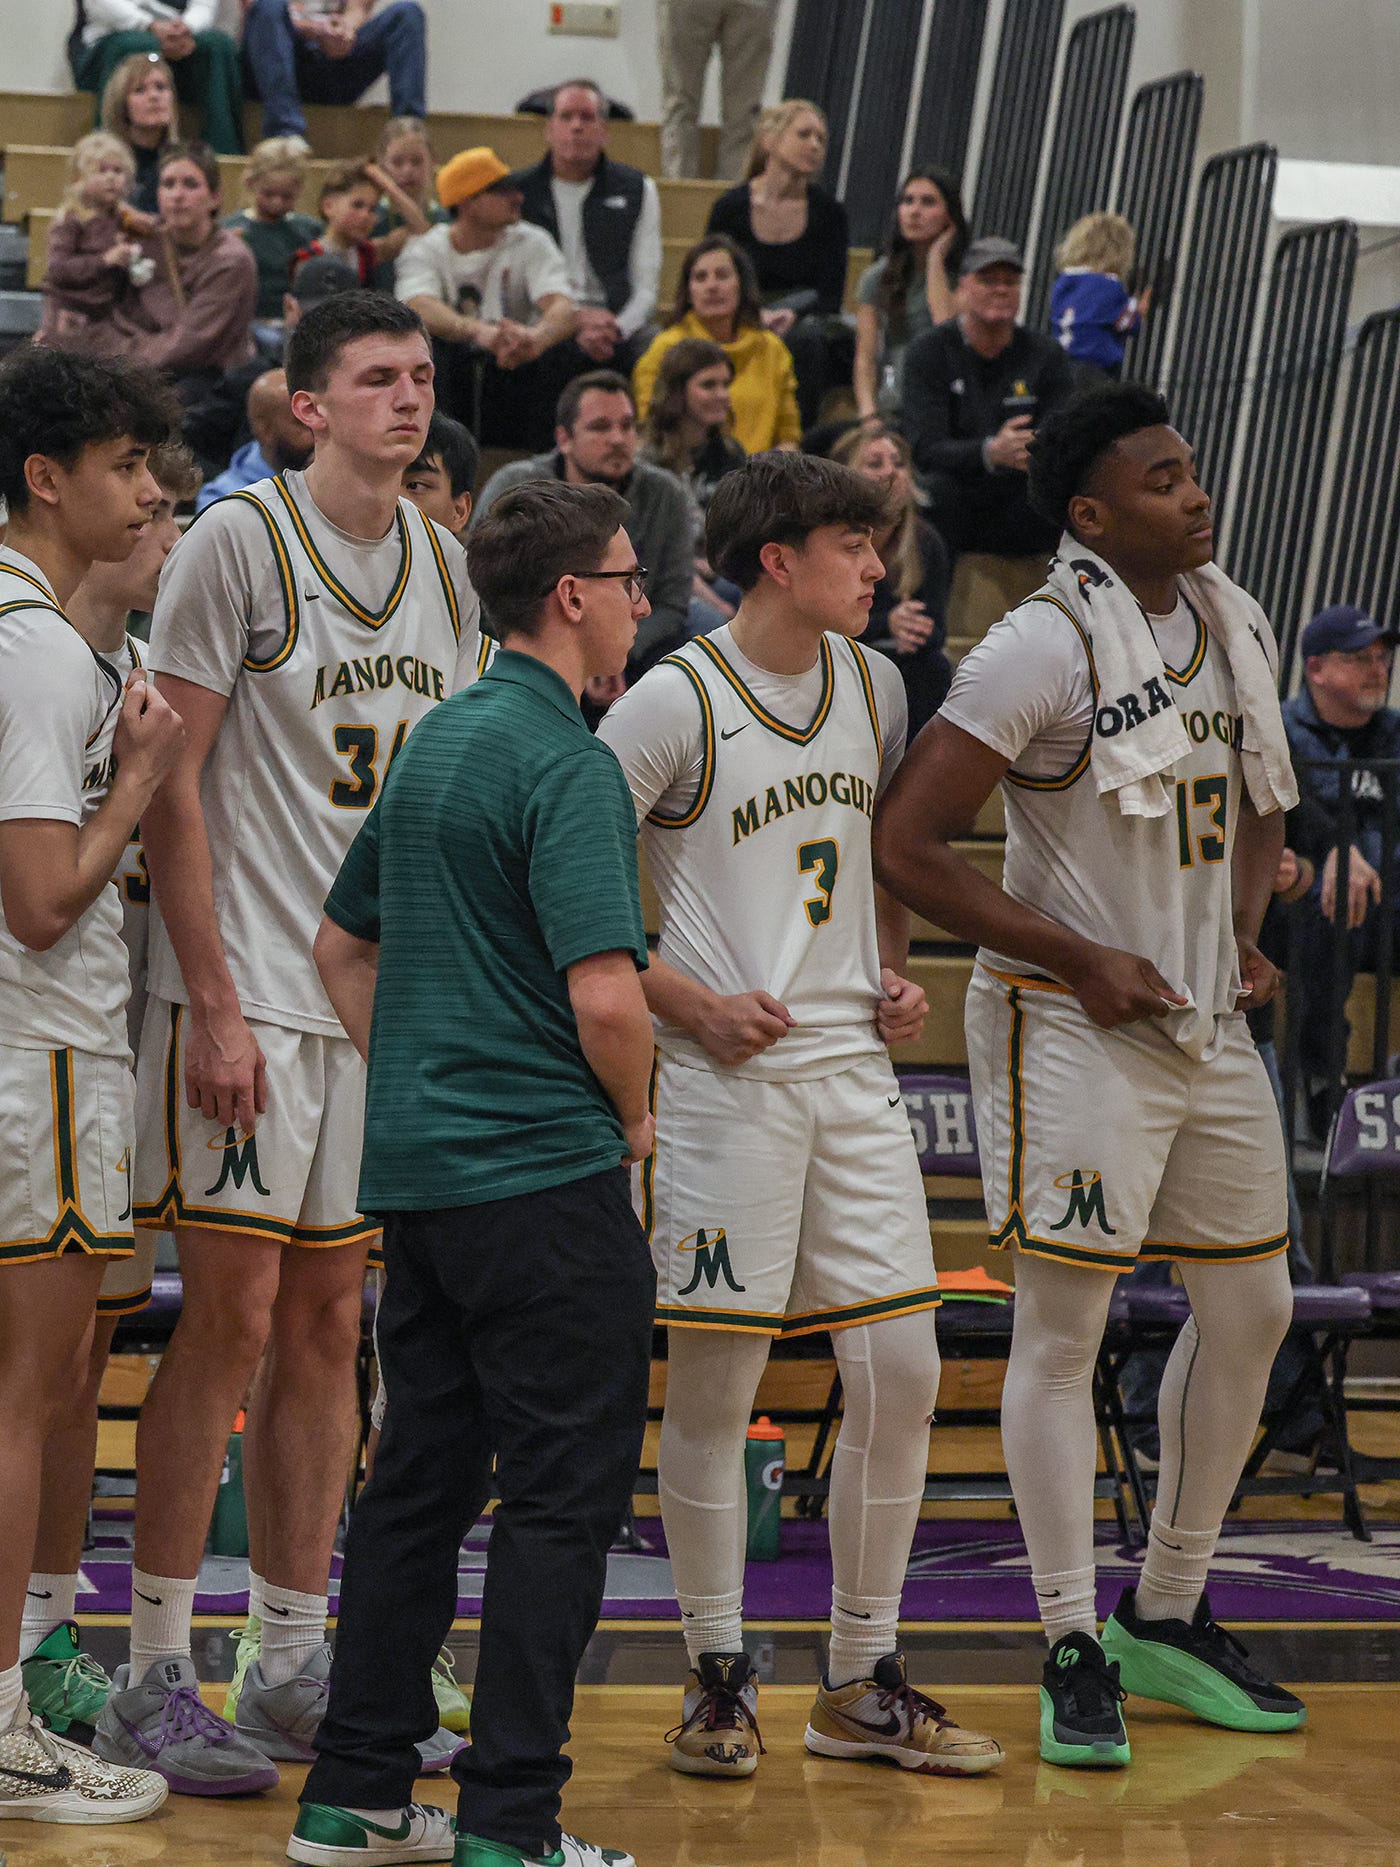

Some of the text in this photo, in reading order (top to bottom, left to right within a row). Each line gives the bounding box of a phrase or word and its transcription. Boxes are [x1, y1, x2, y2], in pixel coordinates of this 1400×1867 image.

[308, 654, 448, 711] MANOGUE
[1095, 676, 1174, 739] ORA
[731, 771, 874, 849] MANOGUE
[1175, 772, 1229, 870] 13
[796, 836, 840, 929] 3
[1354, 1093, 1400, 1150] S
[205, 1124, 271, 1196] M
[1050, 1169, 1116, 1235] M
[677, 1227, 746, 1295] M
